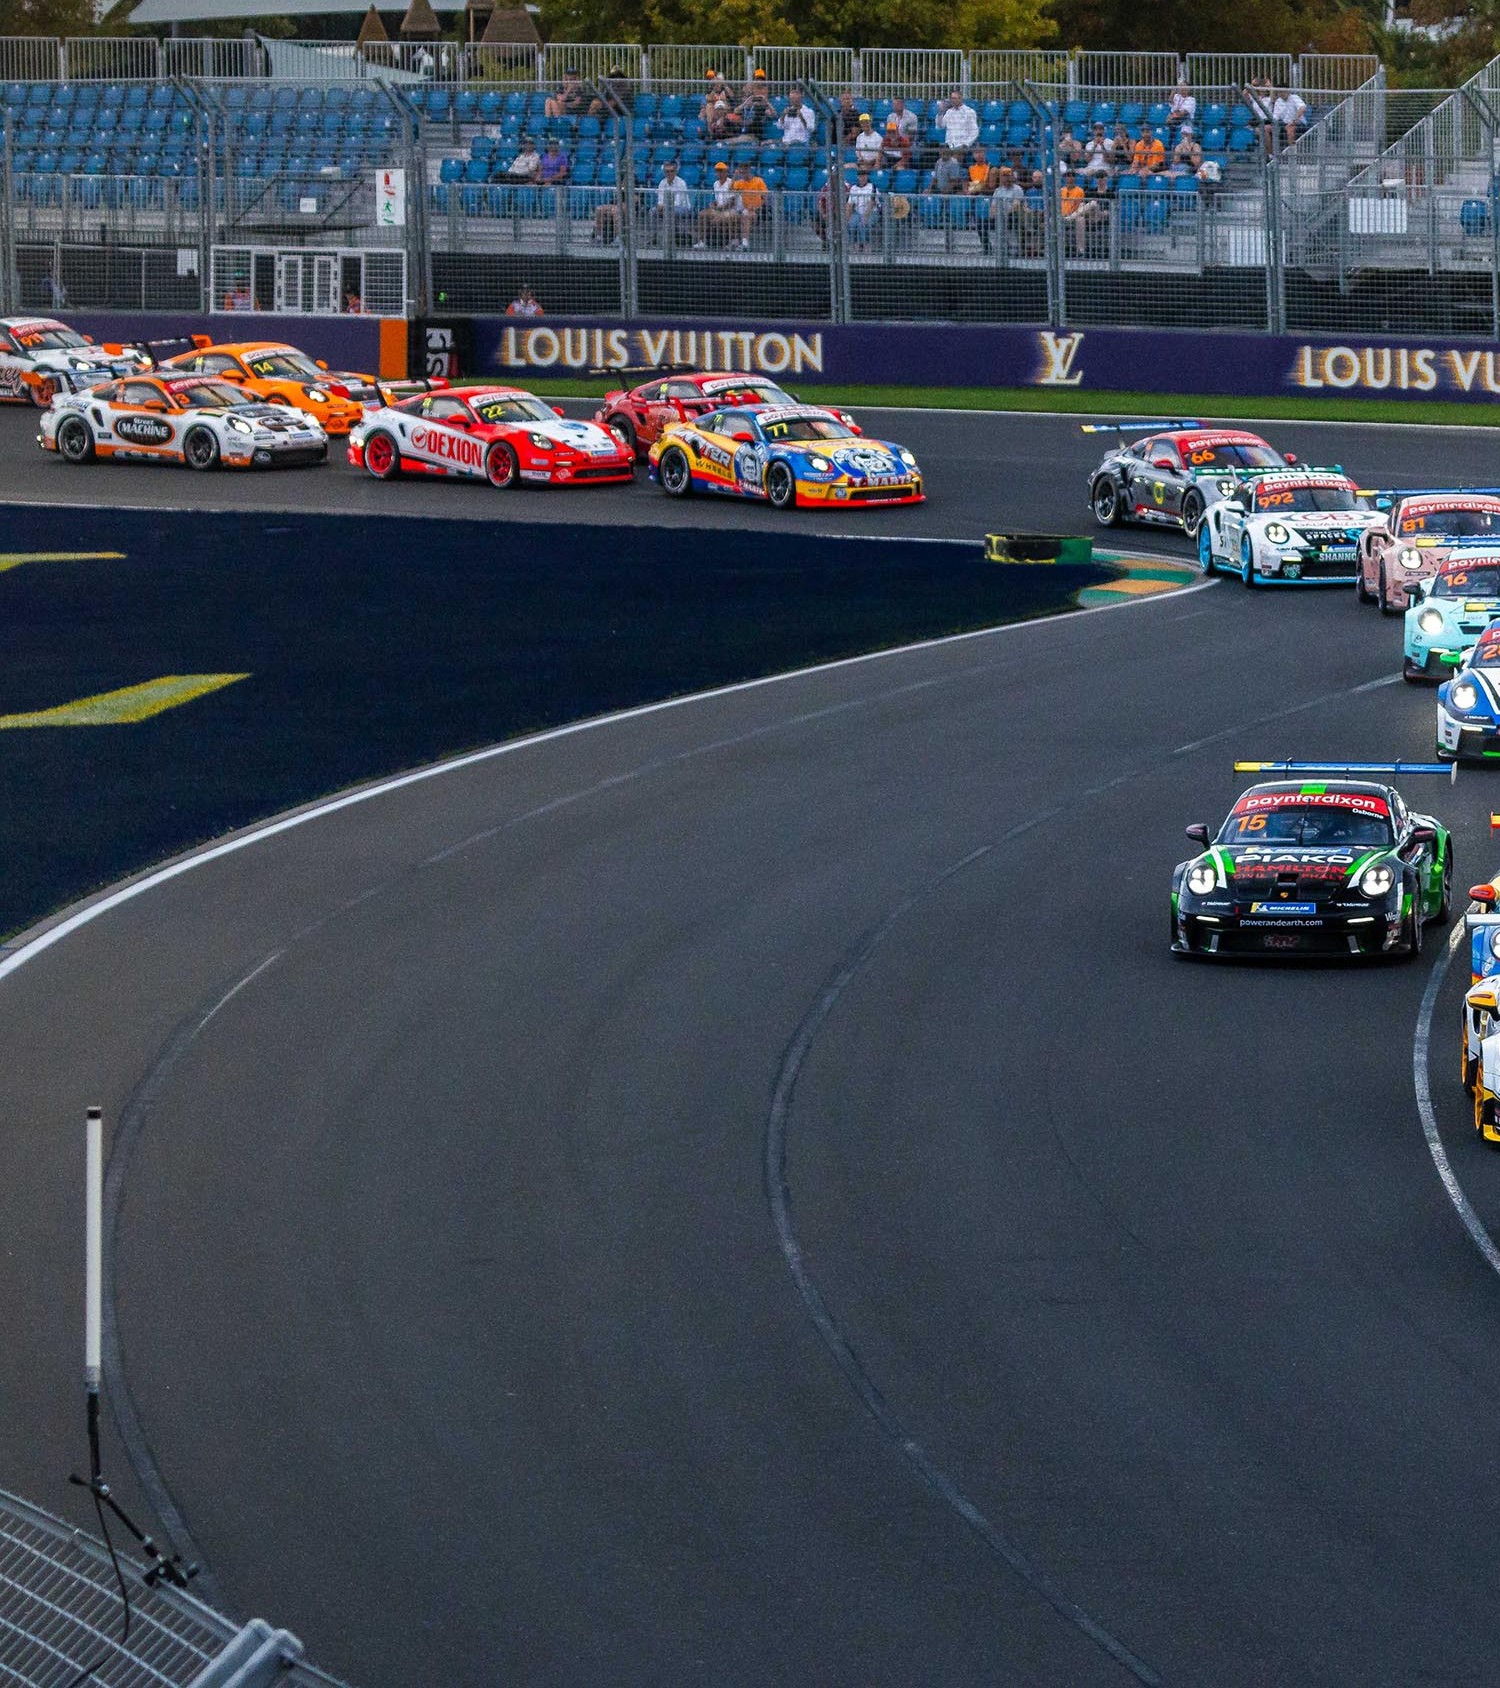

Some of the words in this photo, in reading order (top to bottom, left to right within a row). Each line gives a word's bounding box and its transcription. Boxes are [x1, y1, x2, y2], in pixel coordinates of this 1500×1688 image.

[505, 327, 629, 367] LOUIS
[641, 330, 823, 373] VUITTON
[254, 362, 274, 374] 14
[1300, 346, 1437, 391] LOUIS
[483, 405, 507, 419] 22
[121, 422, 169, 438] MACHINE
[766, 423, 789, 437] 77
[427, 429, 483, 468] DEXION
[1191, 449, 1216, 465] 66
[1263, 479, 1352, 492] paynterdixon
[1257, 491, 1295, 510] 992
[1402, 517, 1425, 532] 81
[1319, 551, 1357, 562] SHANNO
[1442, 571, 1469, 587] 16
[1246, 794, 1377, 809] paynterdixon
[1236, 813, 1269, 833] 15
[1234, 854, 1354, 864] PIAKO
[1235, 863, 1348, 875] HAMILTON
[1239, 919, 1324, 928] powerandearth.com
